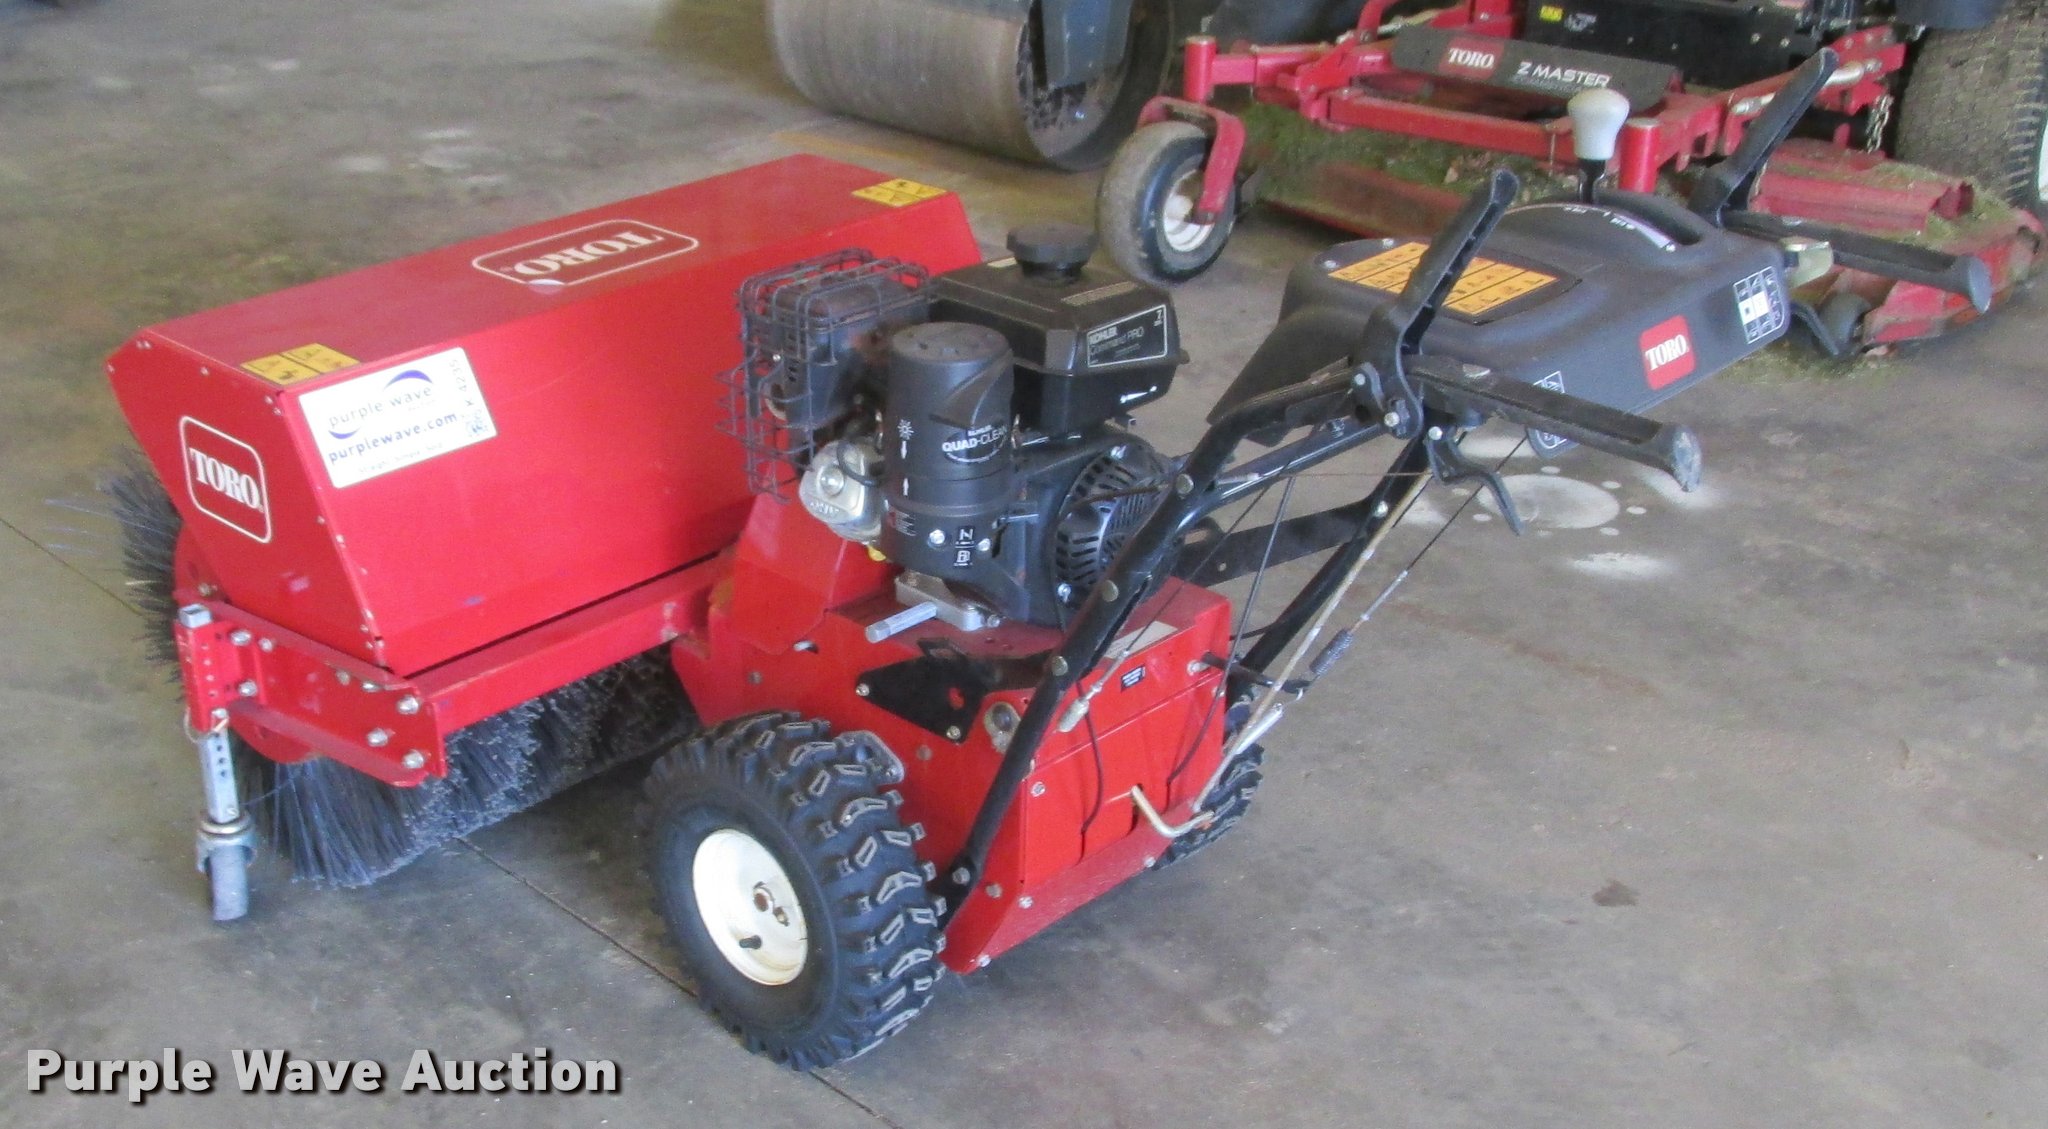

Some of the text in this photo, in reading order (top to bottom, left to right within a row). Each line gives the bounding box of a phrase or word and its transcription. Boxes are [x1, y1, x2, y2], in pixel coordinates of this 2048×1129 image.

[1449, 48, 1495, 69] TORO
[1517, 61, 1532, 75] Z
[1532, 64, 1611, 88] MASTER
[514, 231, 665, 276] TORO
[1645, 334, 1689, 371] TORO
[328, 401, 383, 429] purple
[390, 386, 432, 408] wave
[328, 413, 458, 465] purplewave.com
[189, 447, 260, 509] TORO
